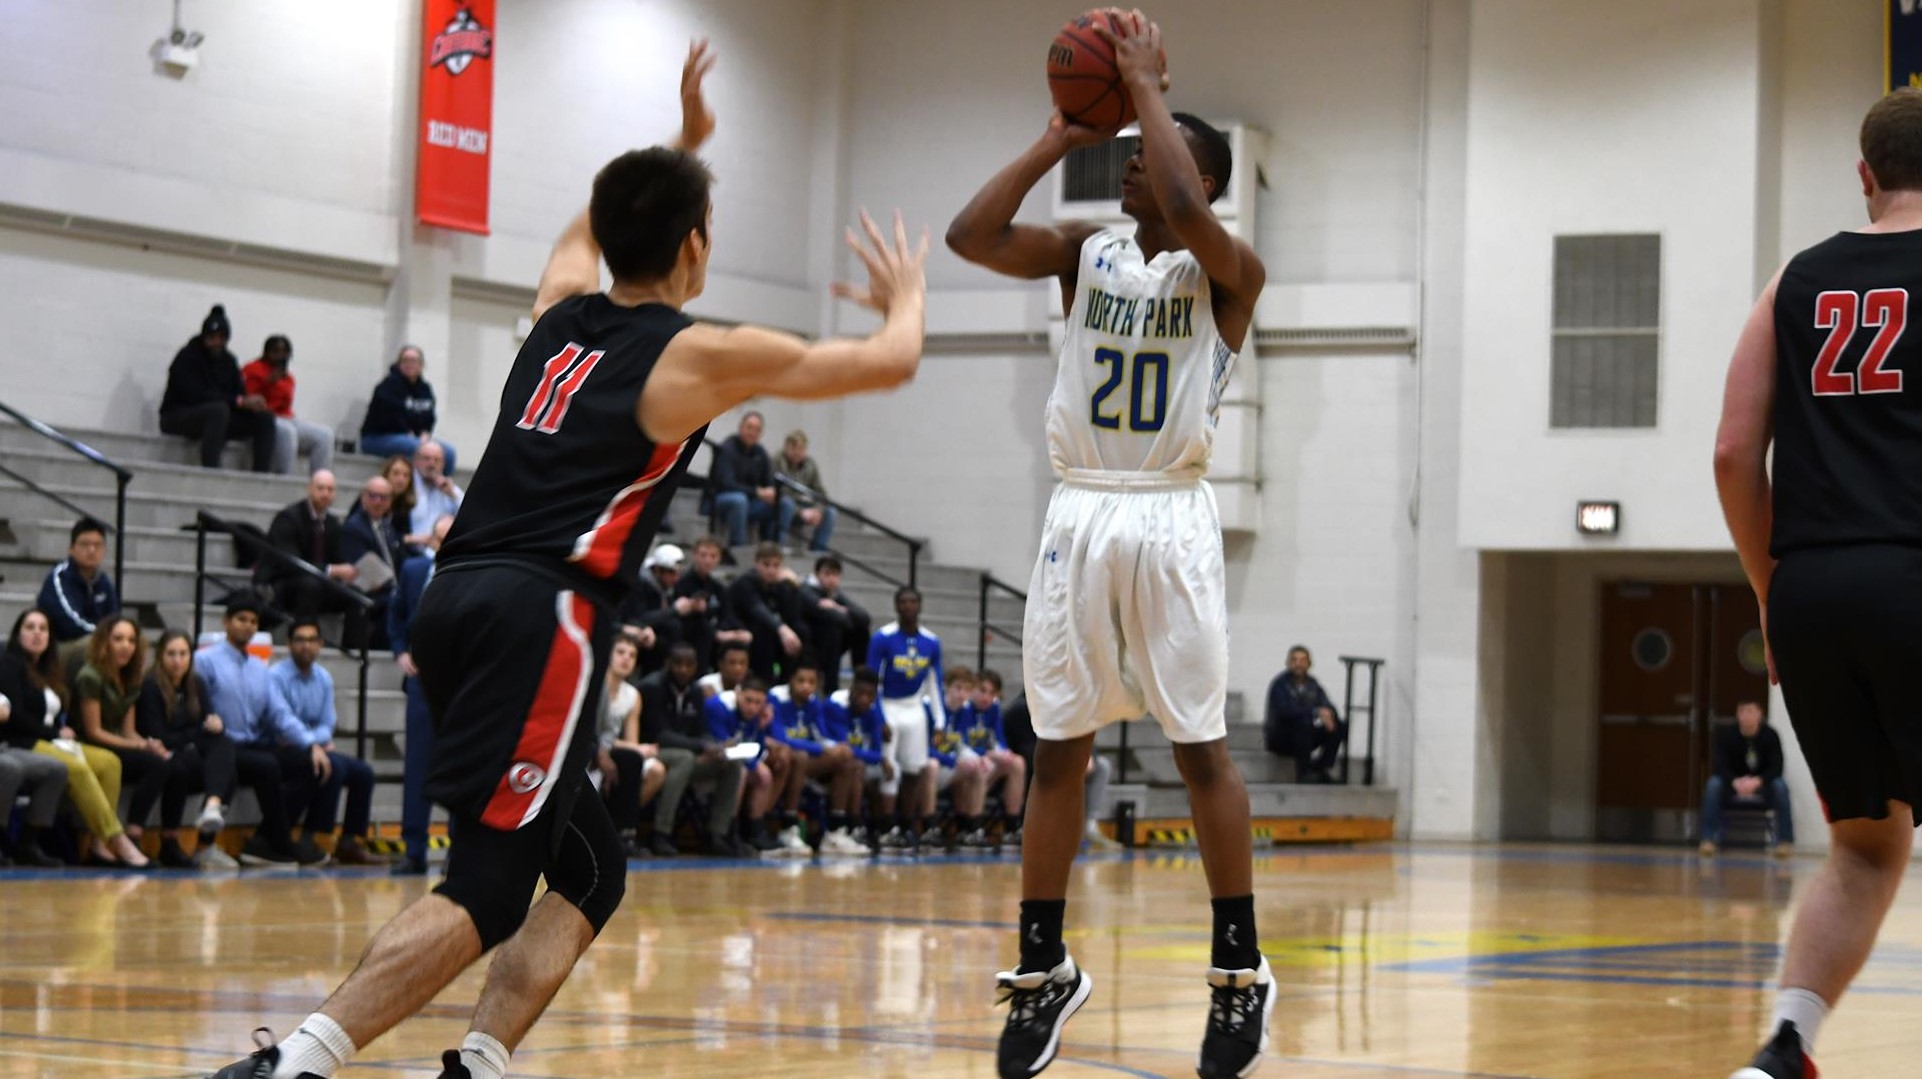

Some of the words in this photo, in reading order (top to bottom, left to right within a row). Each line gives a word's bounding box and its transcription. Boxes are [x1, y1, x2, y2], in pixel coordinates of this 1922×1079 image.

[427, 119, 455, 148] RED
[456, 125, 487, 155] MEN
[1085, 288, 1138, 336] NORTH
[1142, 296, 1194, 338] PARK
[1811, 287, 1909, 396] 22
[515, 341, 607, 435] 11
[1090, 346, 1170, 432] 20
